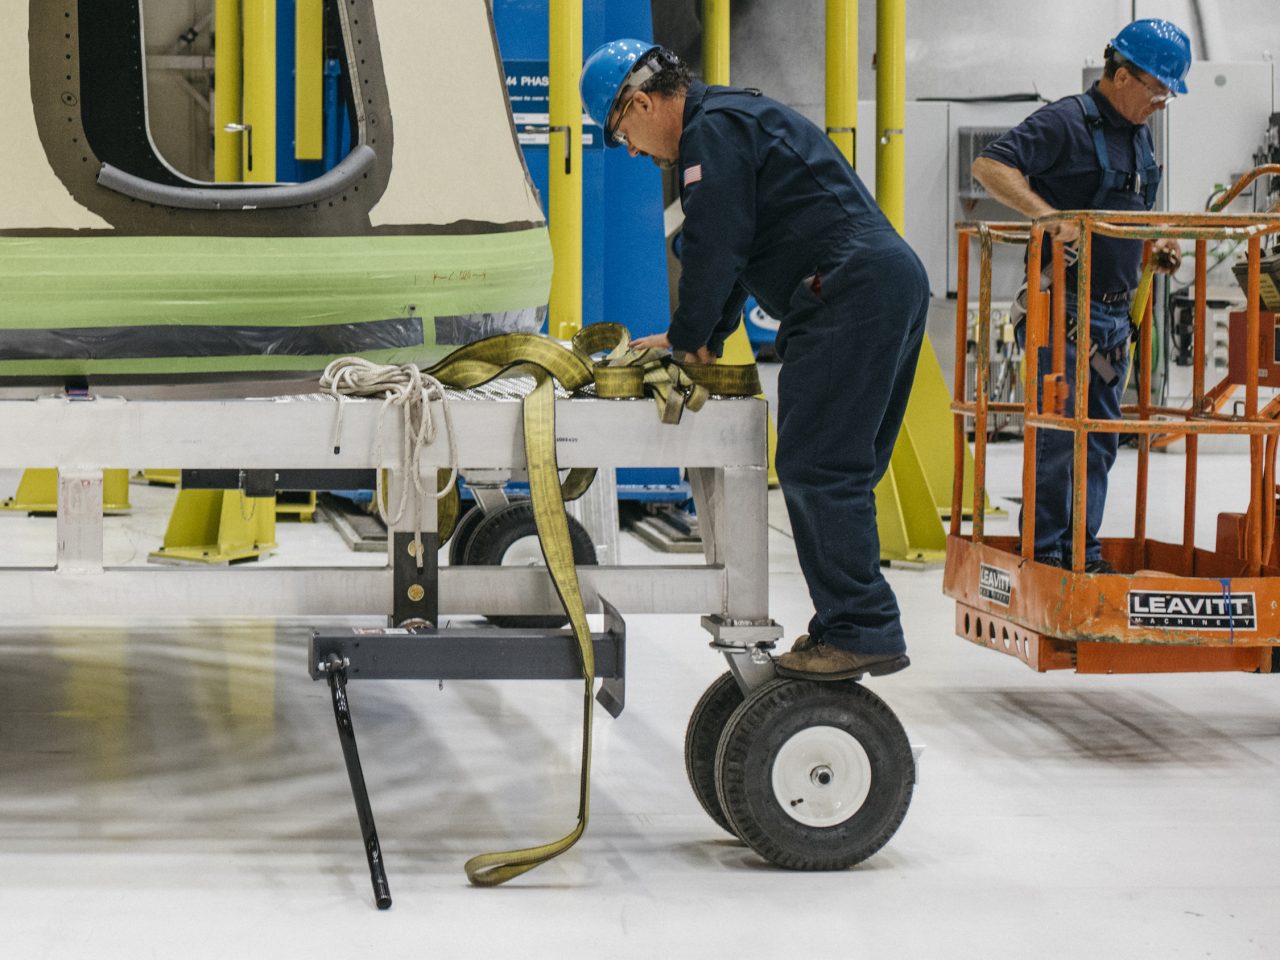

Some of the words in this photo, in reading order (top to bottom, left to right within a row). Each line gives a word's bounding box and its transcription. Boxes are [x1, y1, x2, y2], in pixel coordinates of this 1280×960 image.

[521, 75, 549, 87] PHAS
[980, 567, 1010, 593] LEAVITT
[1134, 596, 1248, 615] LEAVITT
